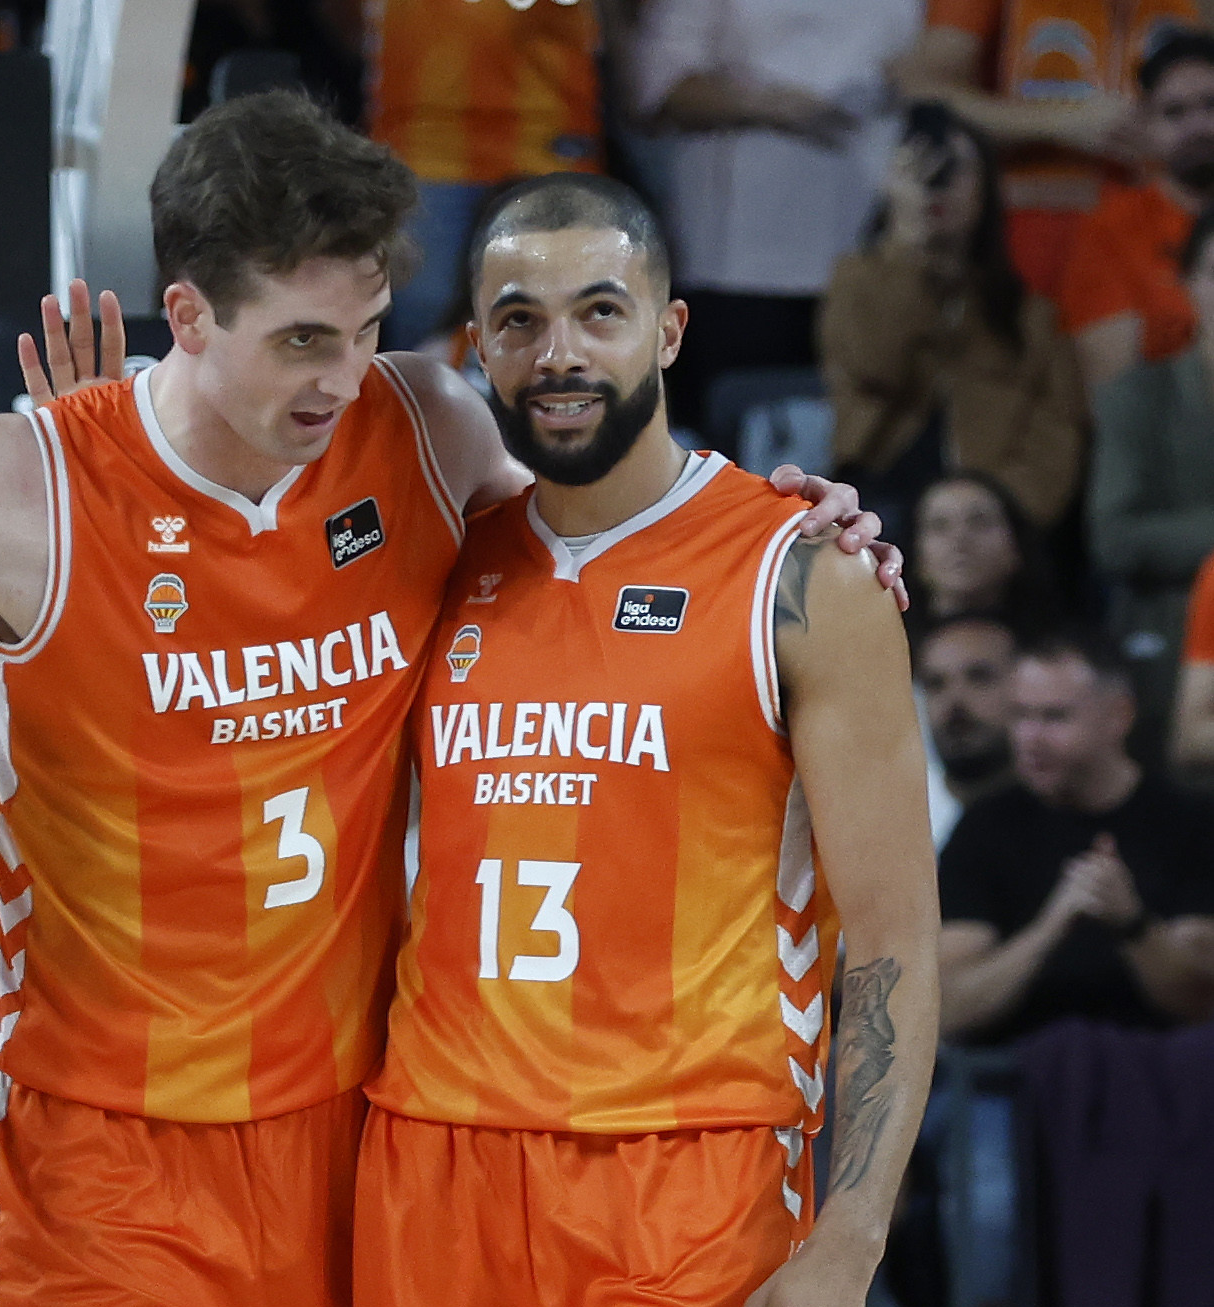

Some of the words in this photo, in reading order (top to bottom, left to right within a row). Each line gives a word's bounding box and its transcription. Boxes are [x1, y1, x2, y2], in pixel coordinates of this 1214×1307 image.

[335, 529, 381, 561] endesa
[620, 613, 678, 627] endesa
[623, 600, 651, 615] liga
[142, 609, 410, 714] VALENCIA
[210, 697, 348, 745] BASKET
[431, 702, 670, 772] VALENCIA
[473, 772, 598, 806] BASKET
[263, 786, 325, 910] 3
[475, 858, 583, 982] 13
